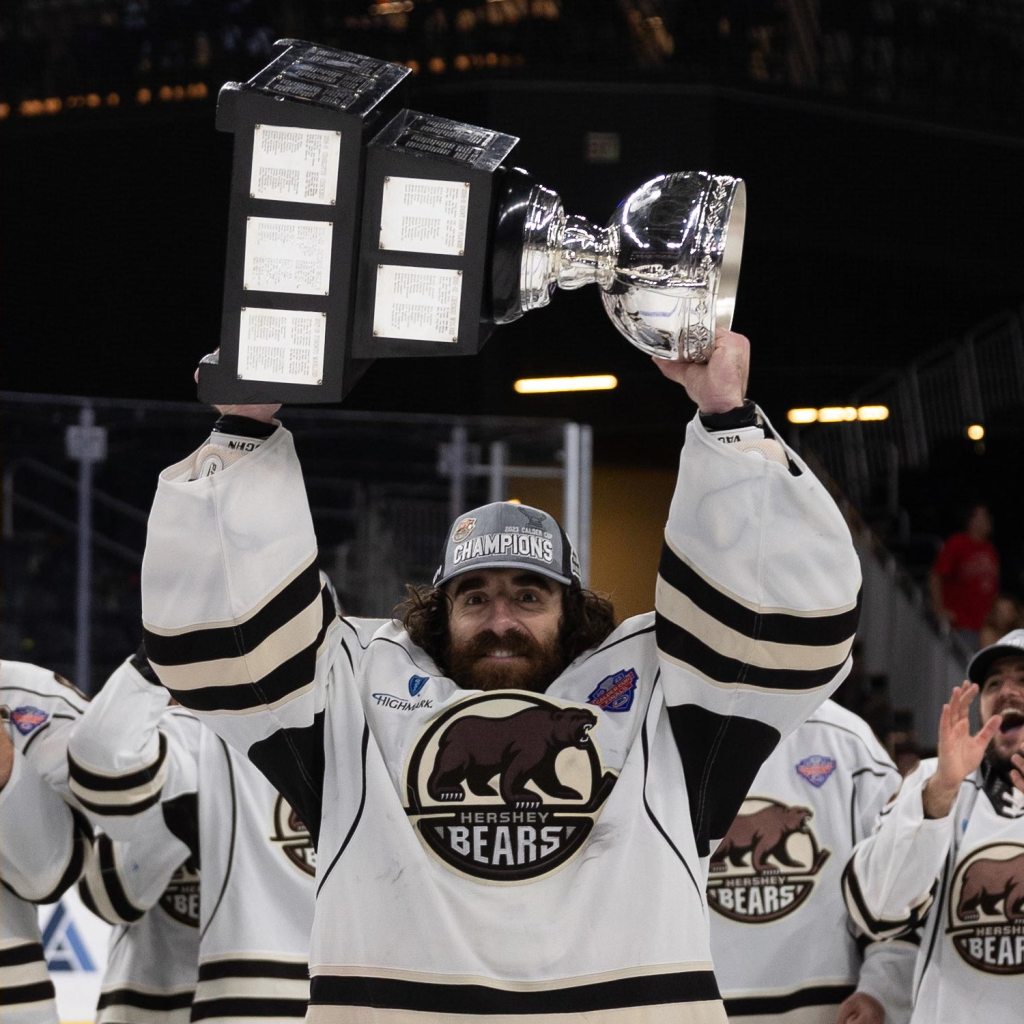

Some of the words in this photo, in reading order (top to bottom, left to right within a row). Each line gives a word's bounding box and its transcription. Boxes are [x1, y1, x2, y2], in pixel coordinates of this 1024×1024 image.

[453, 534, 553, 565] CHAMPIONS
[460, 811, 550, 824] HERSHEY
[448, 825, 564, 866] BEARS
[725, 875, 787, 887] HERSHEY
[718, 884, 796, 915] BEARS
[976, 925, 1024, 936] HERSH
